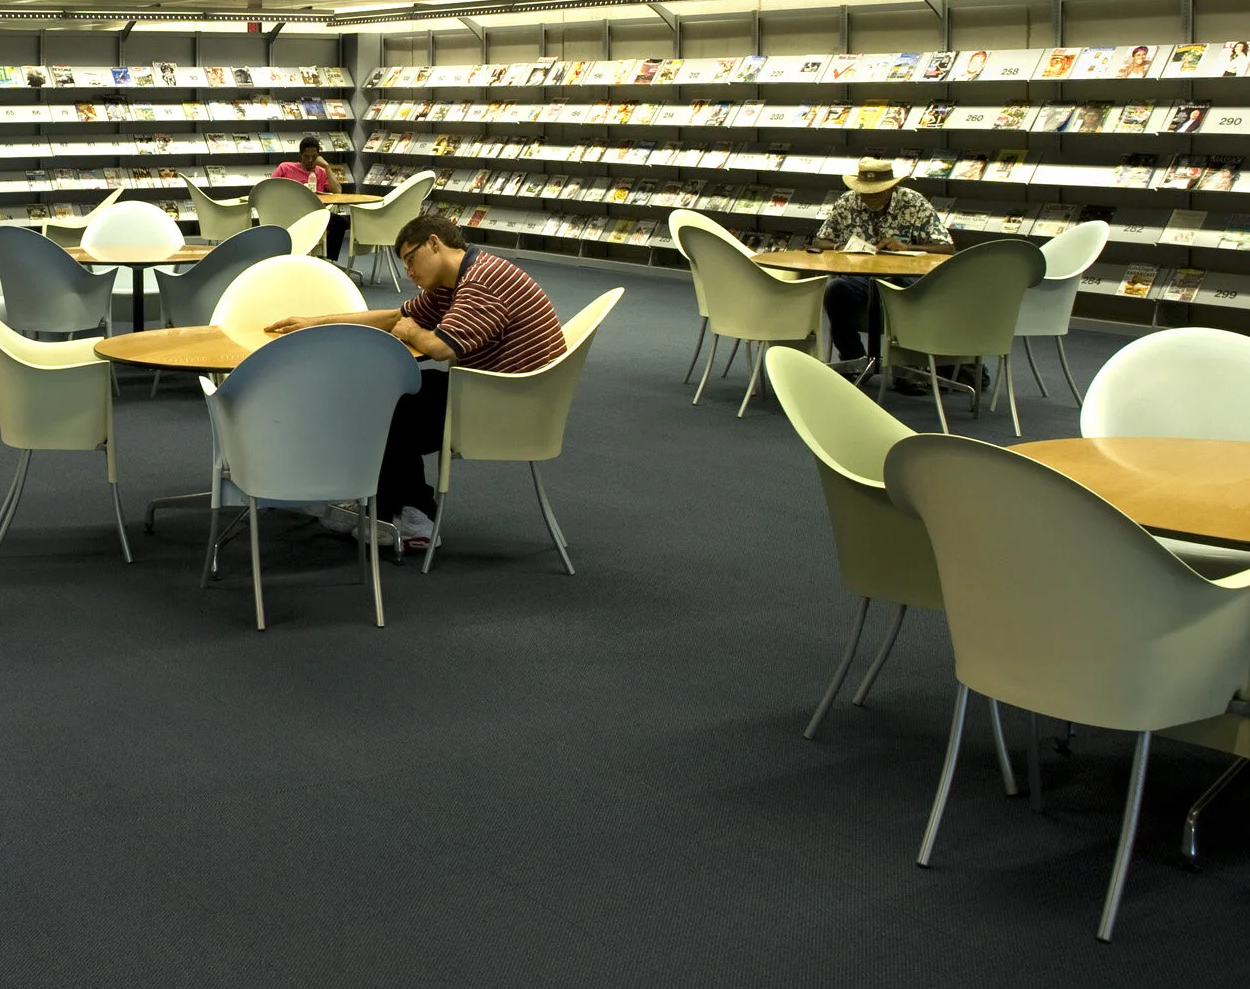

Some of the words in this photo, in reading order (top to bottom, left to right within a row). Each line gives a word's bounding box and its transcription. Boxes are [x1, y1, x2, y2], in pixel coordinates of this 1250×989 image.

[966, 114, 983, 122] 260
[1219, 117, 1242, 126] 290
[1123, 225, 1144, 233] 282
[1081, 276, 1101, 285] 284
[1214, 289, 1238, 299] 299
